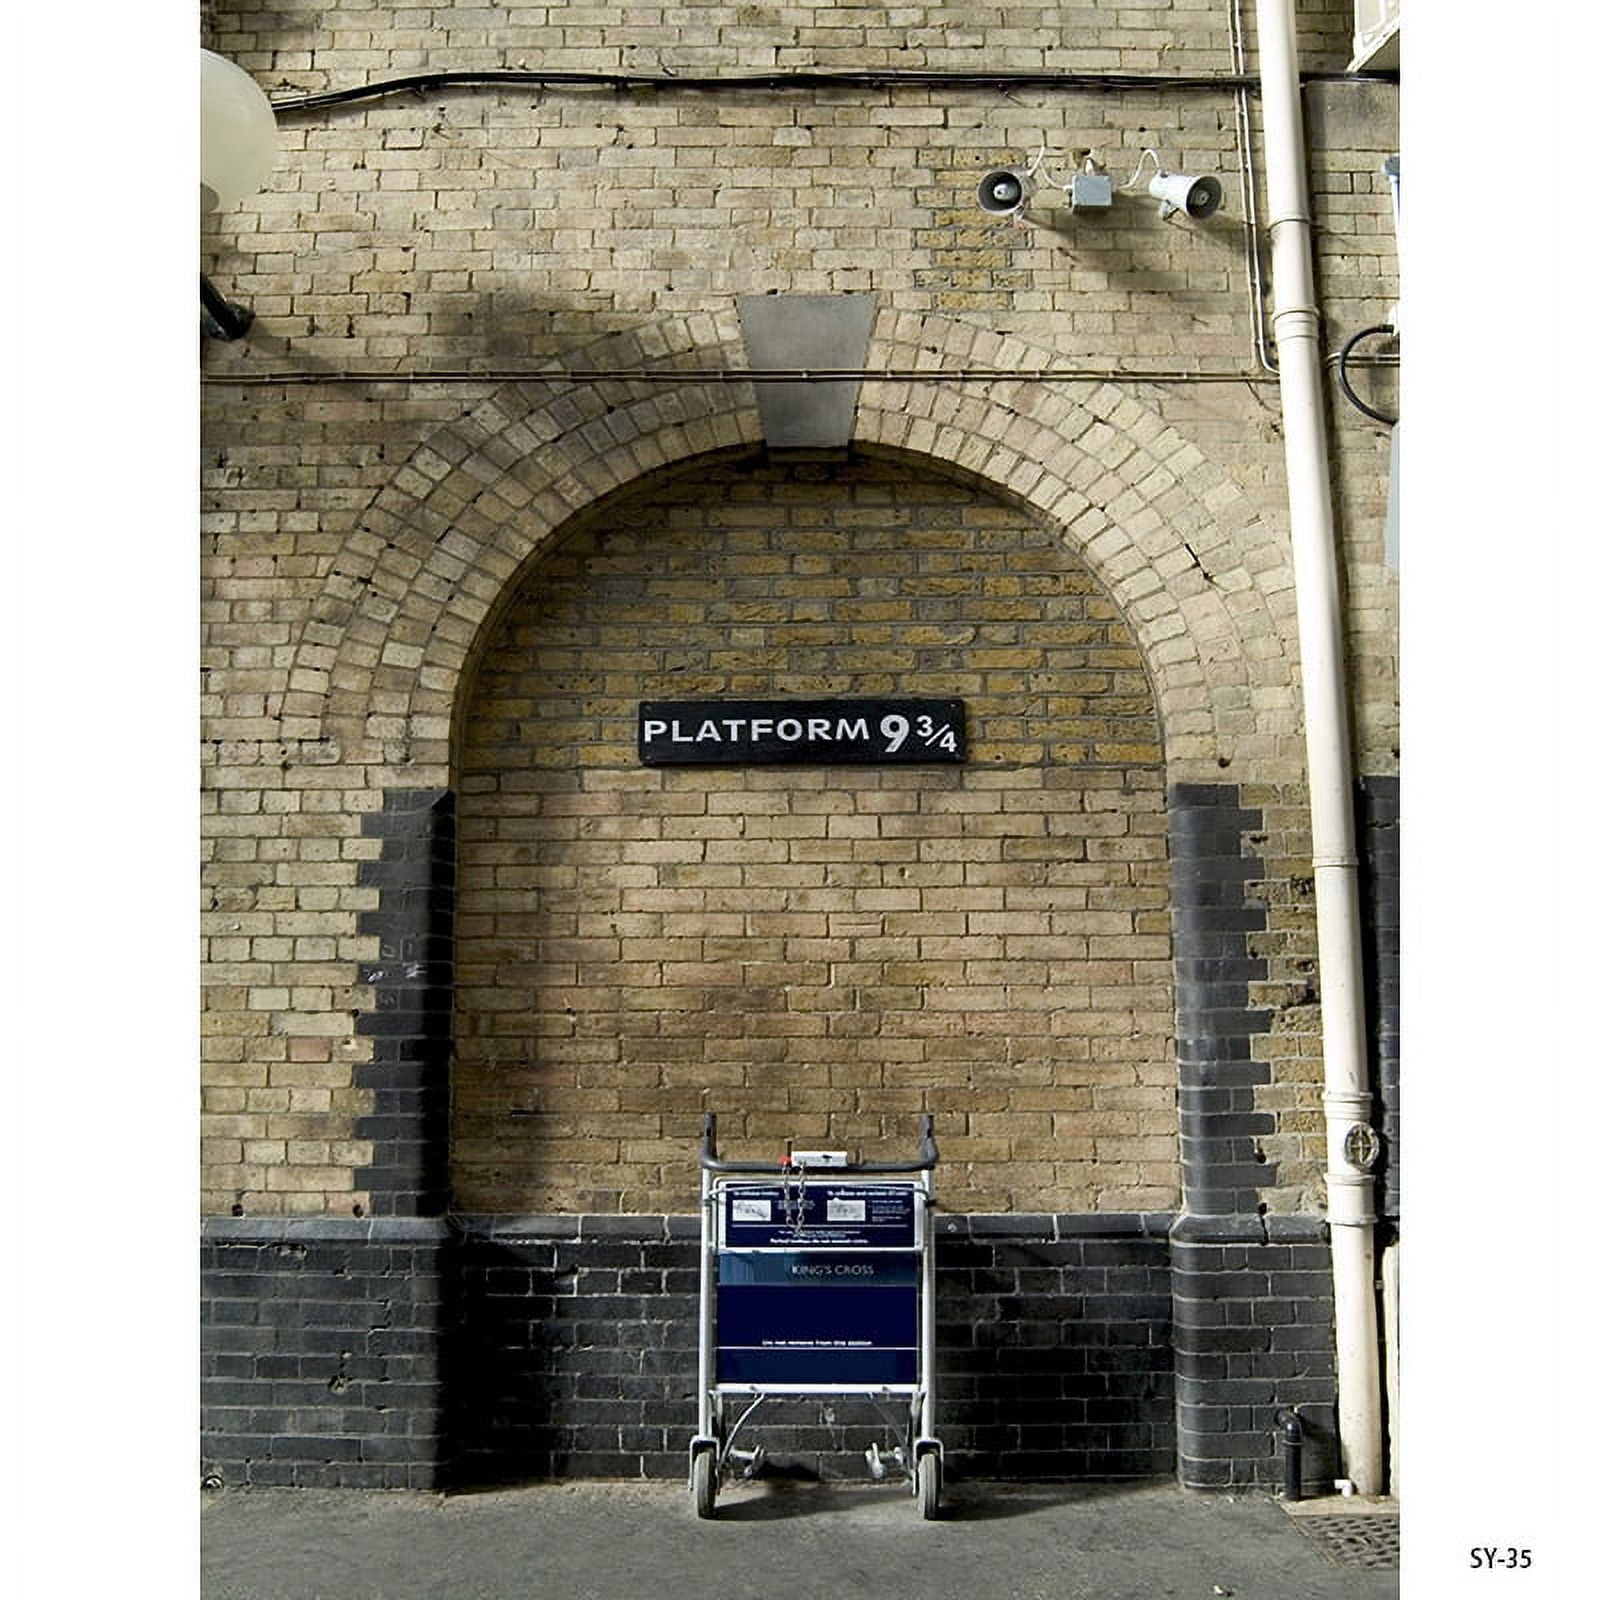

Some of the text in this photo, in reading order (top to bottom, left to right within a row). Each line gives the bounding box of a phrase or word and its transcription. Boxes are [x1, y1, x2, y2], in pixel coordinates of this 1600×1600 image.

[643, 718, 871, 743] PLATFORM
[880, 714, 910, 753] 9
[834, 1263, 874, 1276] CROSS
